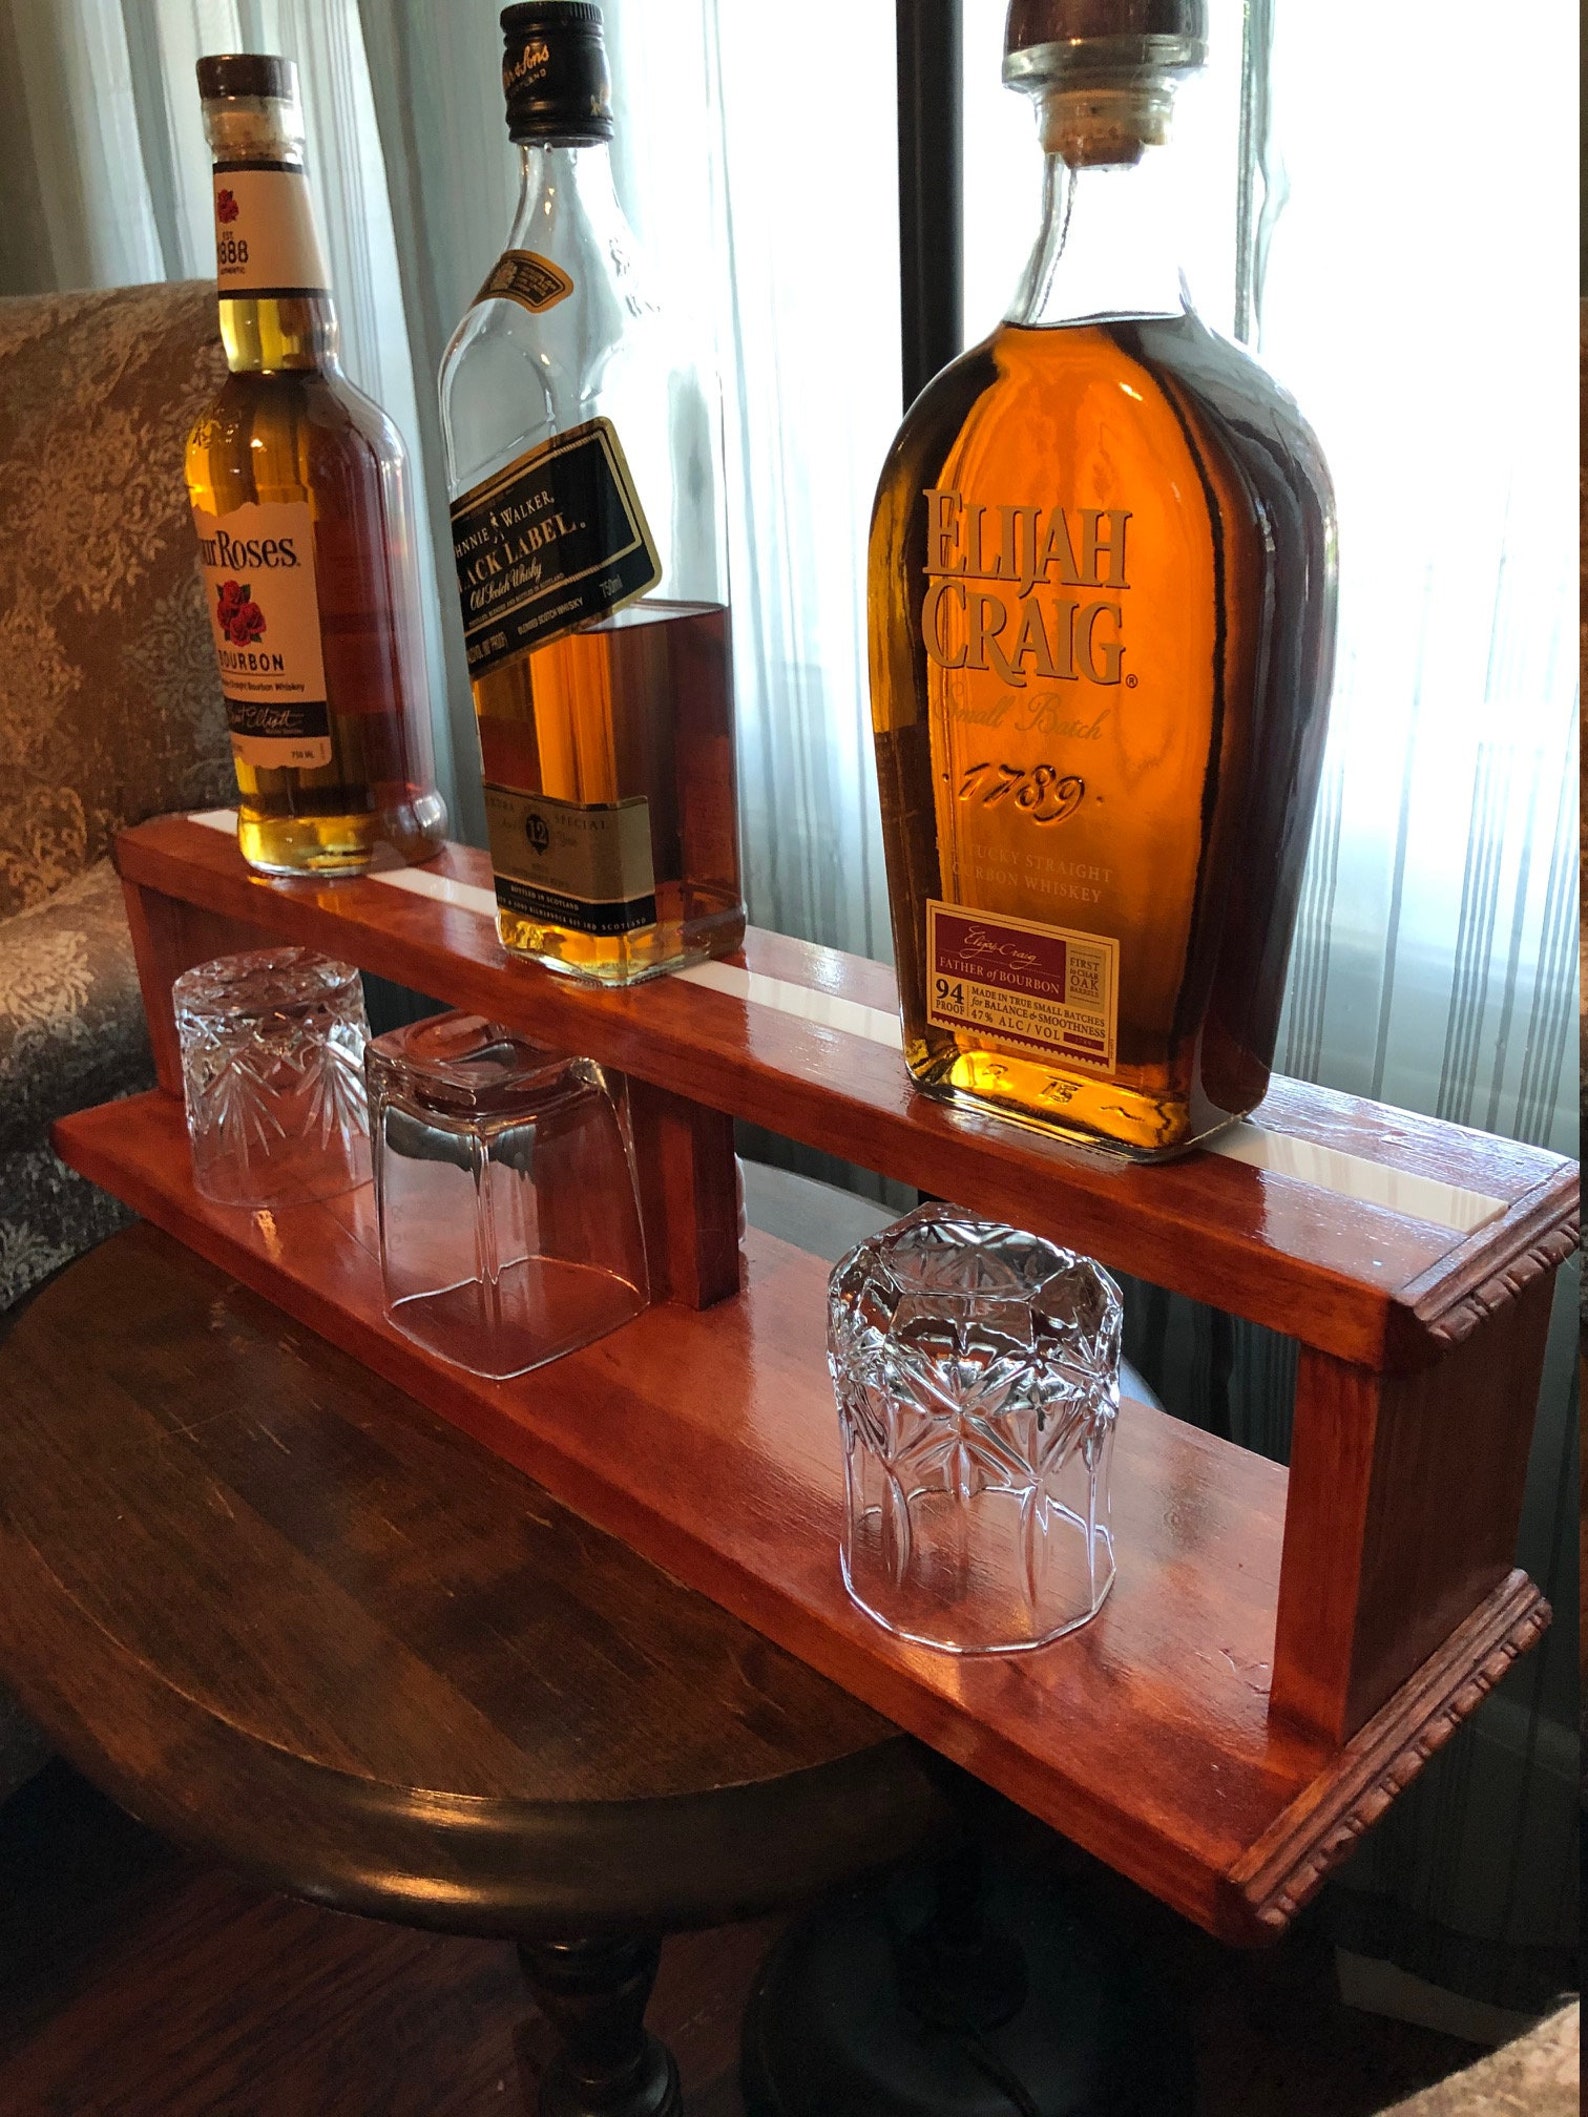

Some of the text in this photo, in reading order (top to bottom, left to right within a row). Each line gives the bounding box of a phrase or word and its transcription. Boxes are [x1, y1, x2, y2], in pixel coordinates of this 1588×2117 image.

[217, 240, 249, 265] 888
[454, 527, 490, 559] HNNIE
[922, 488, 1133, 599] ELIJAH
[459, 551, 503, 593] ACK
[1014, 691, 1111, 740] Batch
[959, 763, 1086, 826] 1789
[529, 819, 547, 844] 12
[1026, 854, 1113, 883] STRAIGHT
[546, 894, 579, 911] SCOTLAND
[1023, 874, 1102, 904] WHISKEY
[999, 943, 1042, 970] Craig
[1070, 957, 1100, 972] FIRST
[940, 956, 1060, 994] FATHER of BOURBON
[1070, 975, 1099, 991] OAK
[935, 978, 965, 1005] 94
[935, 1000, 965, 1016] PROOF
[971, 986, 1105, 1028] MADE IN TRUE SMALL BATCHES
[971, 996, 983, 1007] for
[984, 1001, 1028, 1019] BALANCE
[1038, 1016, 1106, 1039] SMOOTHNESS
[971, 1008, 994, 1023] 47%
[999, 1016, 1024, 1032] ALC
[1034, 1024, 1062, 1041] VOL
